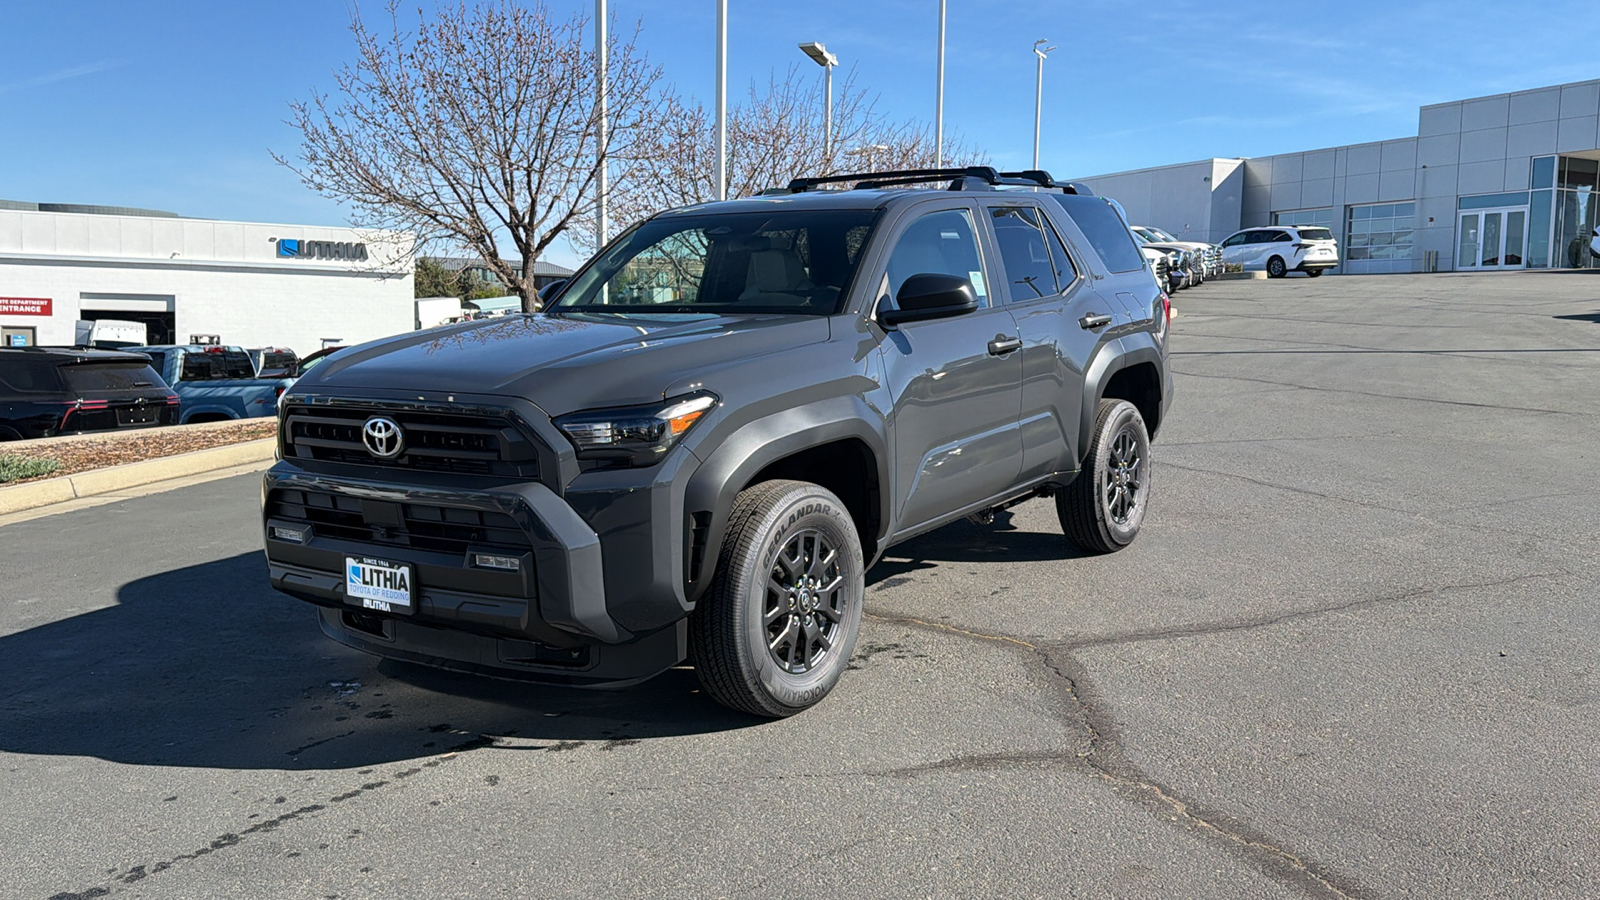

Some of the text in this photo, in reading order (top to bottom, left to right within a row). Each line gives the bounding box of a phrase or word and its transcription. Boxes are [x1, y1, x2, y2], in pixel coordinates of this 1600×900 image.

[297, 239, 369, 262] LITHIA
[763, 503, 831, 570] GEOLANDAR
[362, 566, 409, 592] LITHIA
[349, 584, 410, 601] TOYOTA OF REDDING
[369, 599, 392, 612] LITHIA
